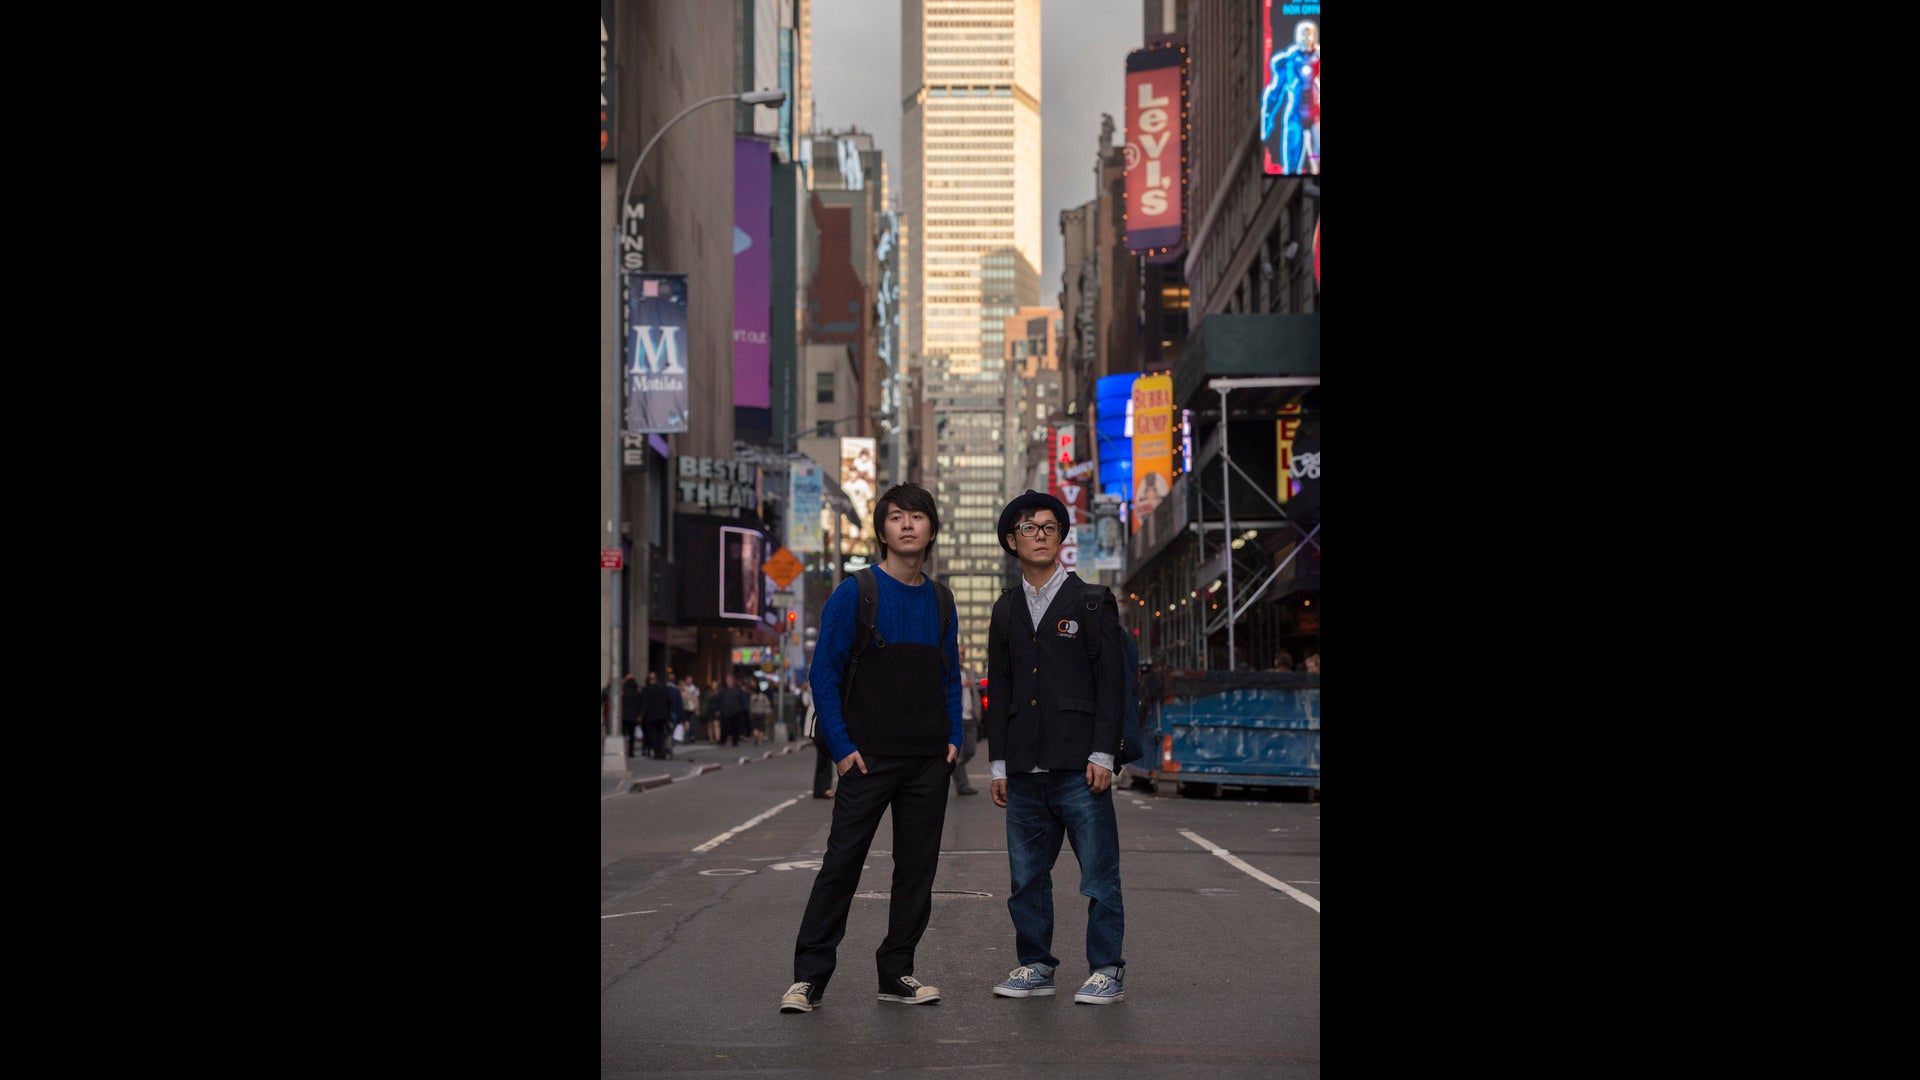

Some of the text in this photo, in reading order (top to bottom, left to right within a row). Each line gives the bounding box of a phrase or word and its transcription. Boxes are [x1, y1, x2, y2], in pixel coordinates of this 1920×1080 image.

[1138, 82, 1171, 216] Levi's
[630, 325, 685, 374] M
[632, 376, 683, 392] Matilda
[1134, 387, 1170, 411] BUBBA
[1136, 413, 1168, 435] GUMP
